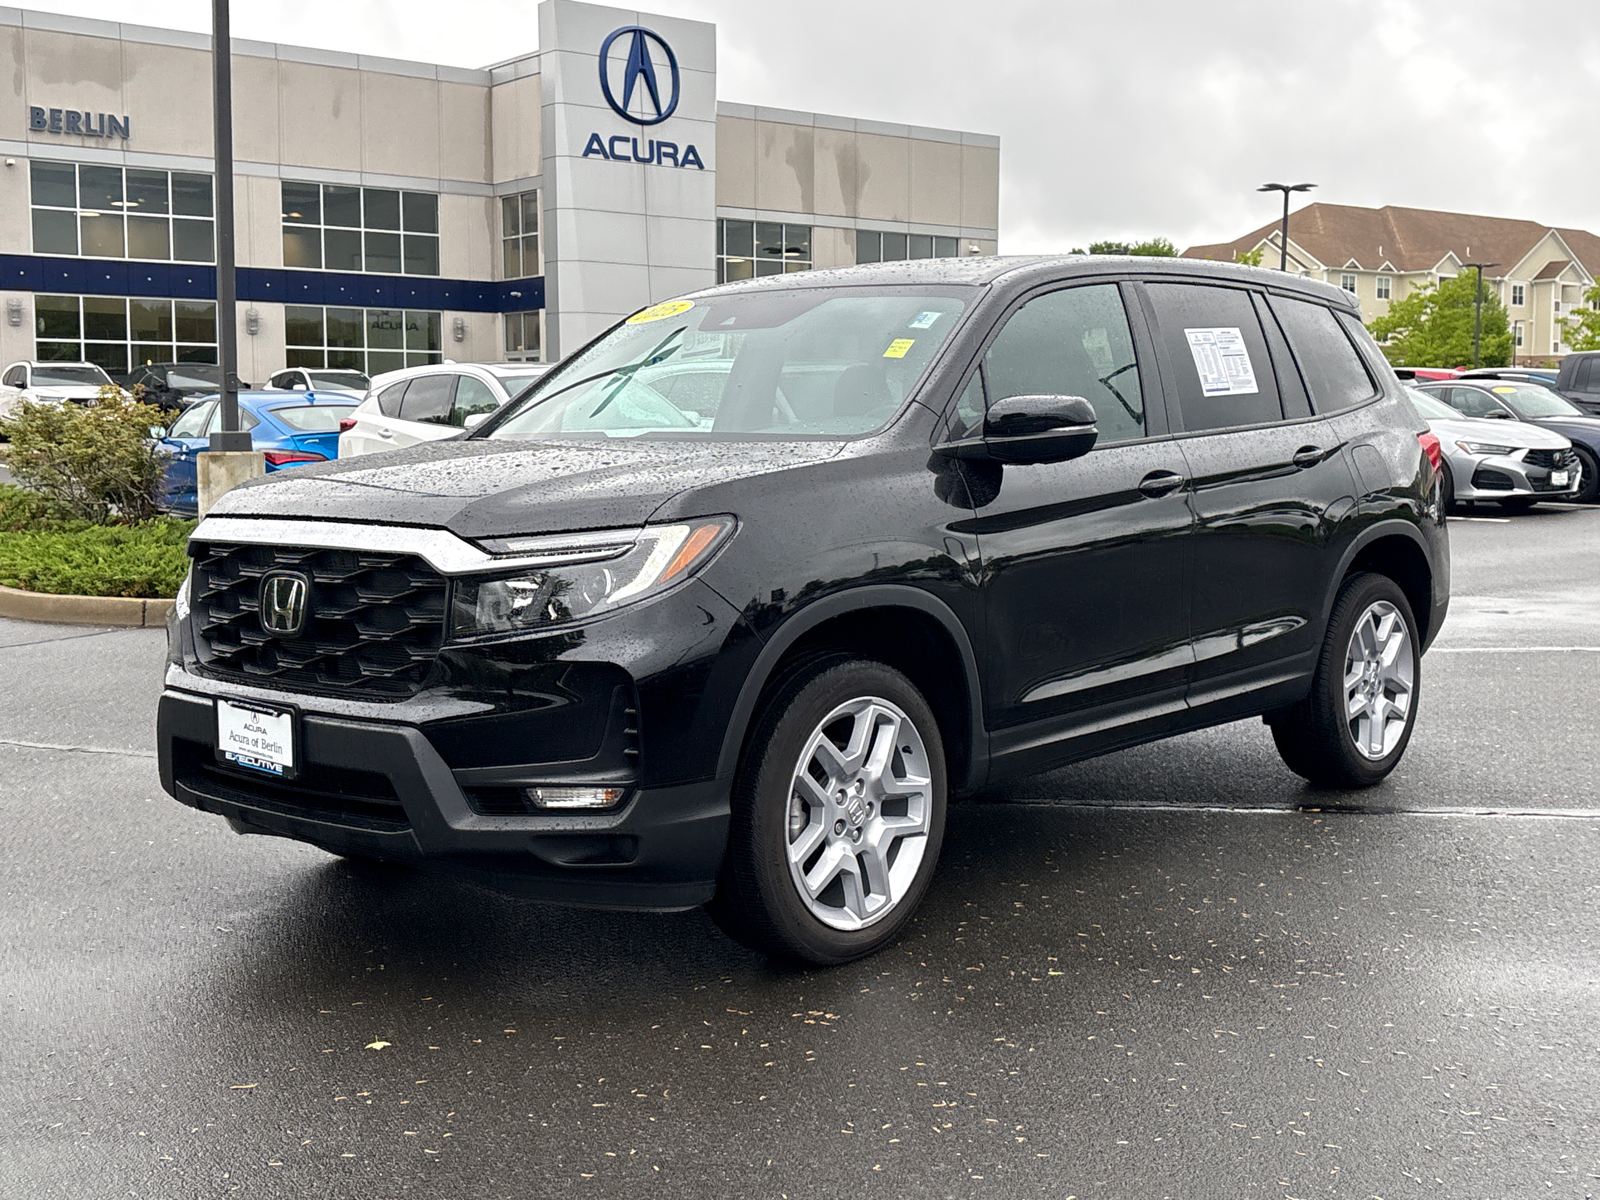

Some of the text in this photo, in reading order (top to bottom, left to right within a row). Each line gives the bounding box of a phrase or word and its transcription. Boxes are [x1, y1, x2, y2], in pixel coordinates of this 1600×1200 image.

[29, 106, 130, 139] BERLIN
[582, 133, 704, 169] ACURA
[371, 321, 419, 331] ACURA
[243, 723, 267, 735] ACURA
[229, 730, 283, 754] Acura of Berlin
[225, 751, 283, 773] EXECUTIVE
